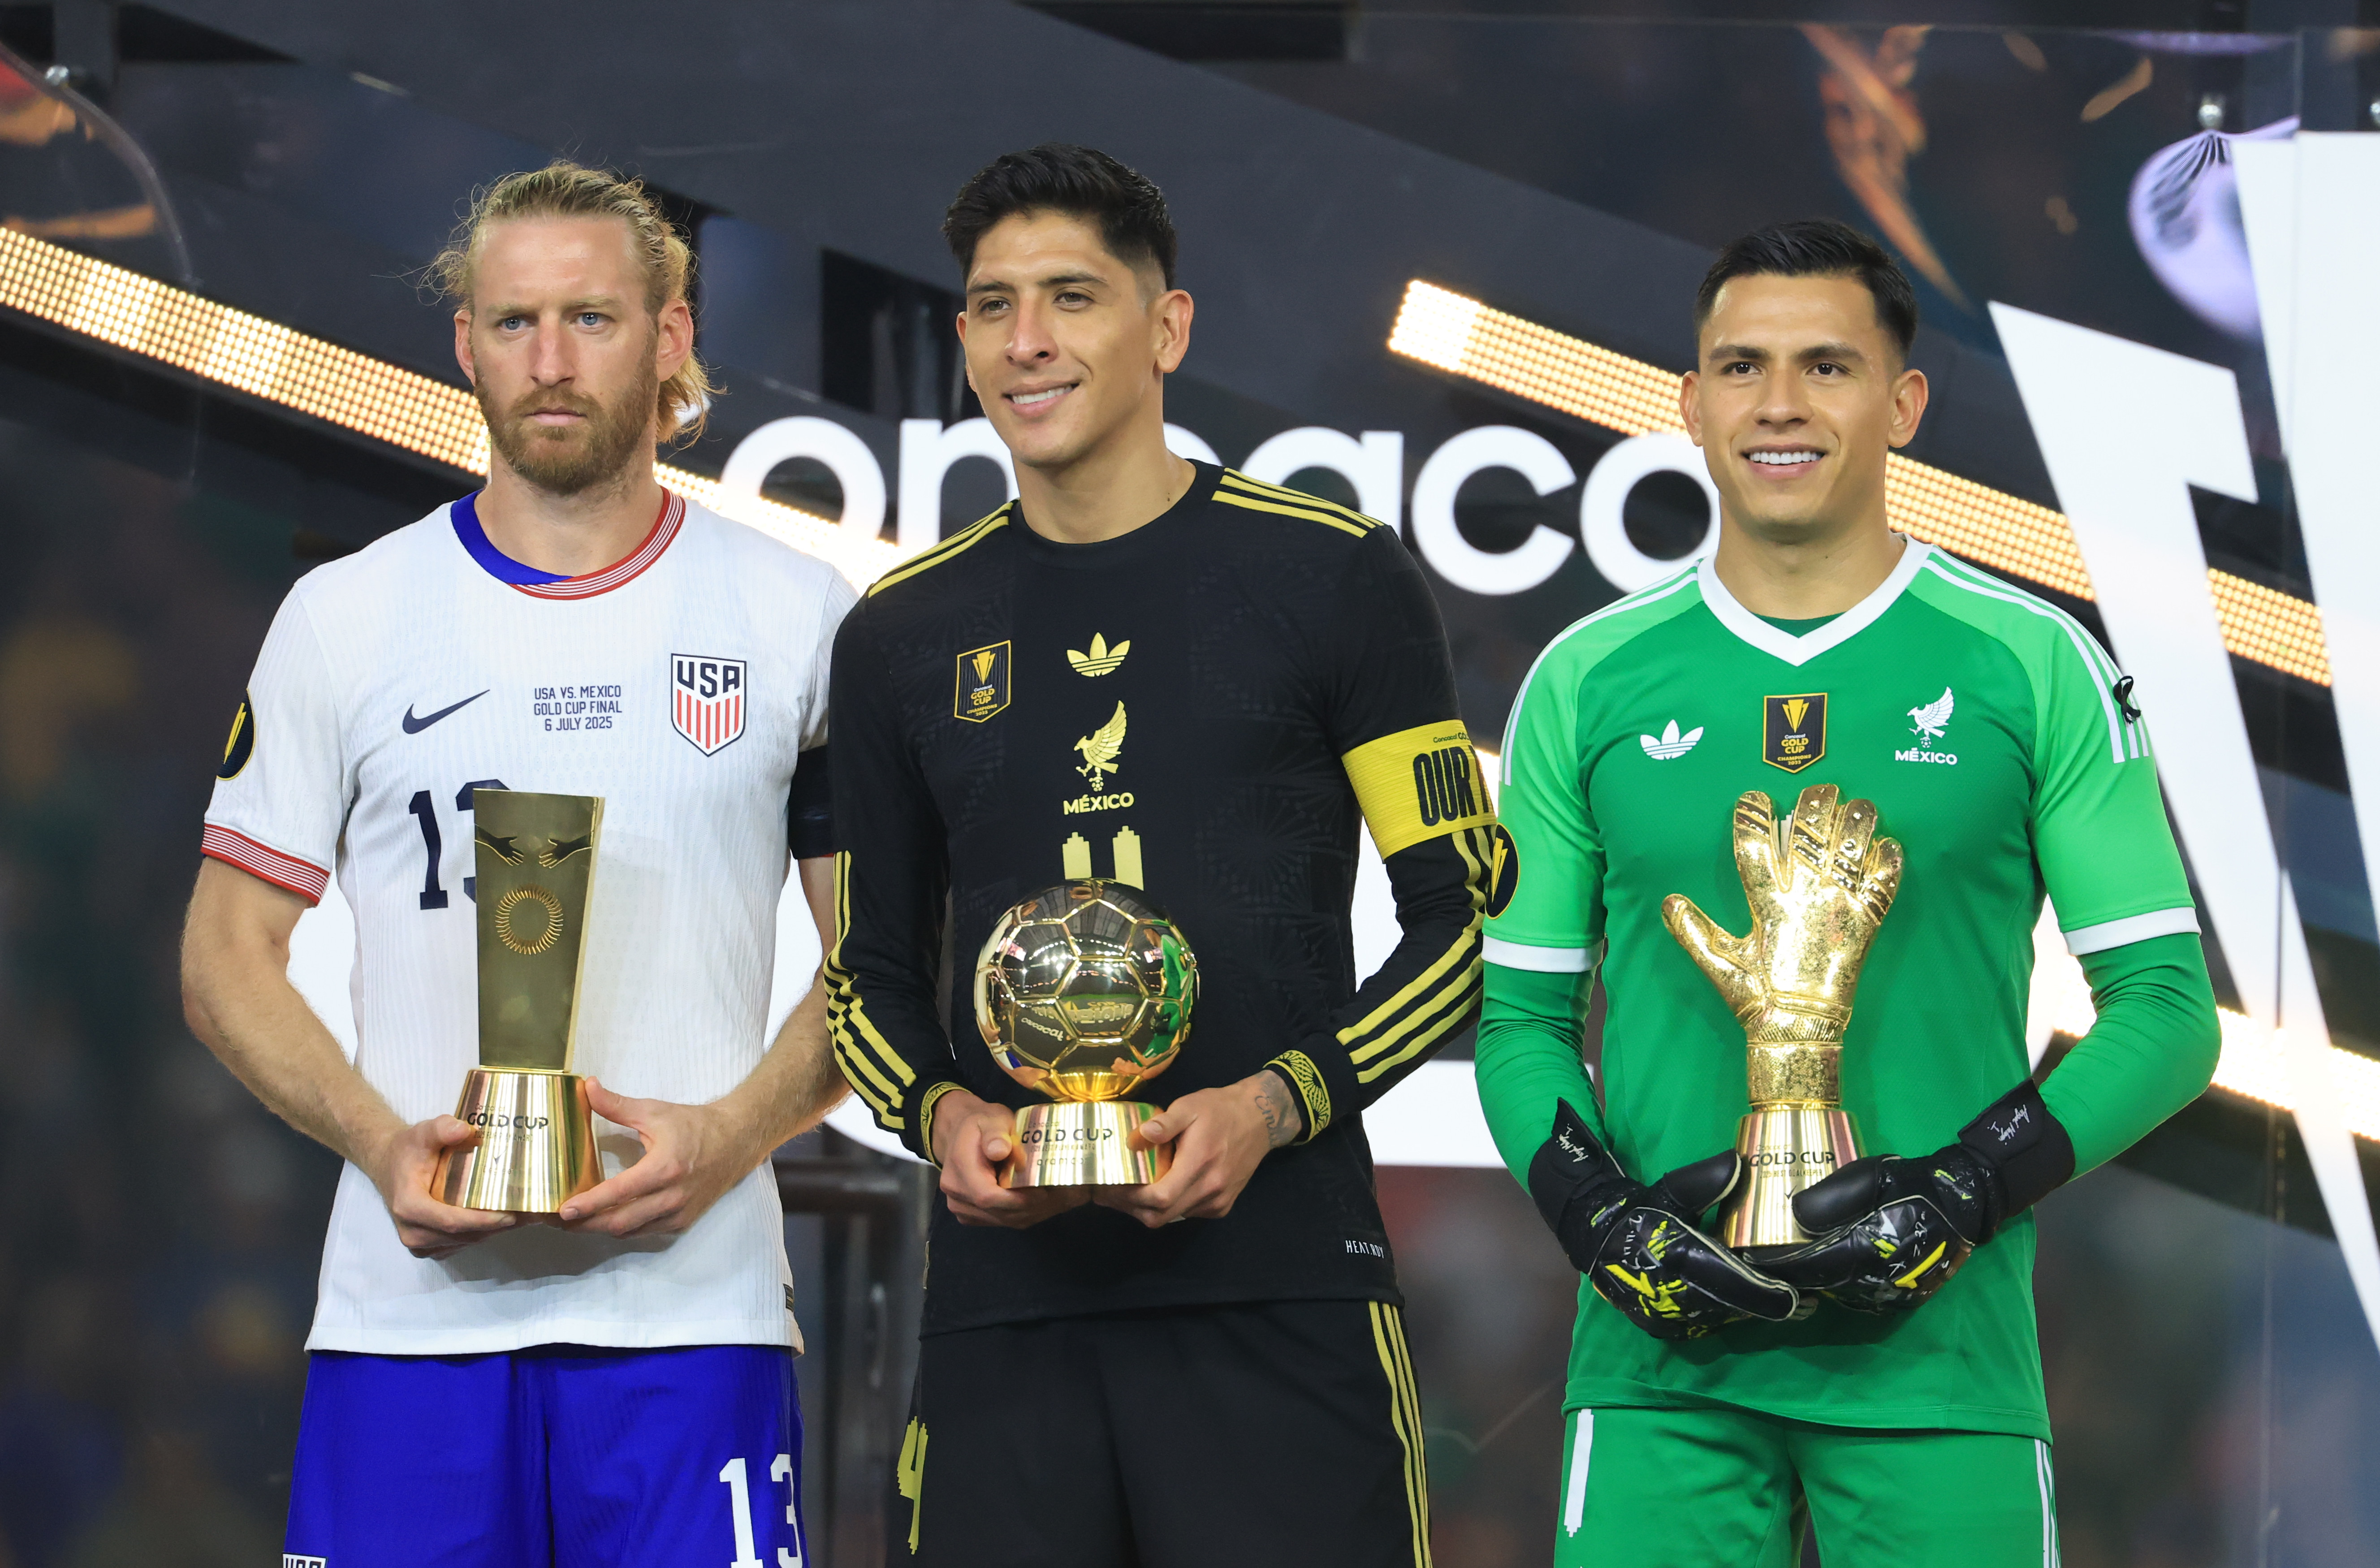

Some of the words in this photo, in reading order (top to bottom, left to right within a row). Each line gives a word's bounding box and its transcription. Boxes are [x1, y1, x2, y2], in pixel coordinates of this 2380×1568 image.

[674, 389, 1722, 596] onaca
[677, 661, 740, 699] USA
[534, 687, 556, 700] USA
[560, 687, 576, 699] VS.
[580, 685, 621, 698] MEXICO
[971, 688, 995, 699] GOLD
[534, 702, 562, 715] GOLD
[566, 701, 586, 714] CUP
[590, 700, 622, 713] FINAL
[973, 696, 991, 705] CUP
[967, 704, 998, 714] CHAMPIONS
[545, 718, 552, 731] 6
[556, 717, 581, 730] JULY
[585, 716, 612, 729] 2025
[1781, 738, 1809, 747] GOLD
[1784, 746, 1805, 754] CUP
[1895, 747, 1957, 765] MÉXICO
[1413, 747, 1477, 827] OUR
[1063, 792, 1134, 815] MÉXICO
[409, 778, 512, 910] 1
[467, 1112, 510, 1127] GOLD
[513, 1115, 549, 1129] CUP
[514, 1134, 533, 1142] AWARD
[1021, 1129, 1066, 1143] GOLD
[1073, 1128, 1113, 1141] CUP
[1749, 1152, 1796, 1166] GOLD
[1801, 1151, 1835, 1164] CUP
[1345, 1240, 1384, 1259] HEAT.RDY
[719, 1453, 803, 1568] 13
